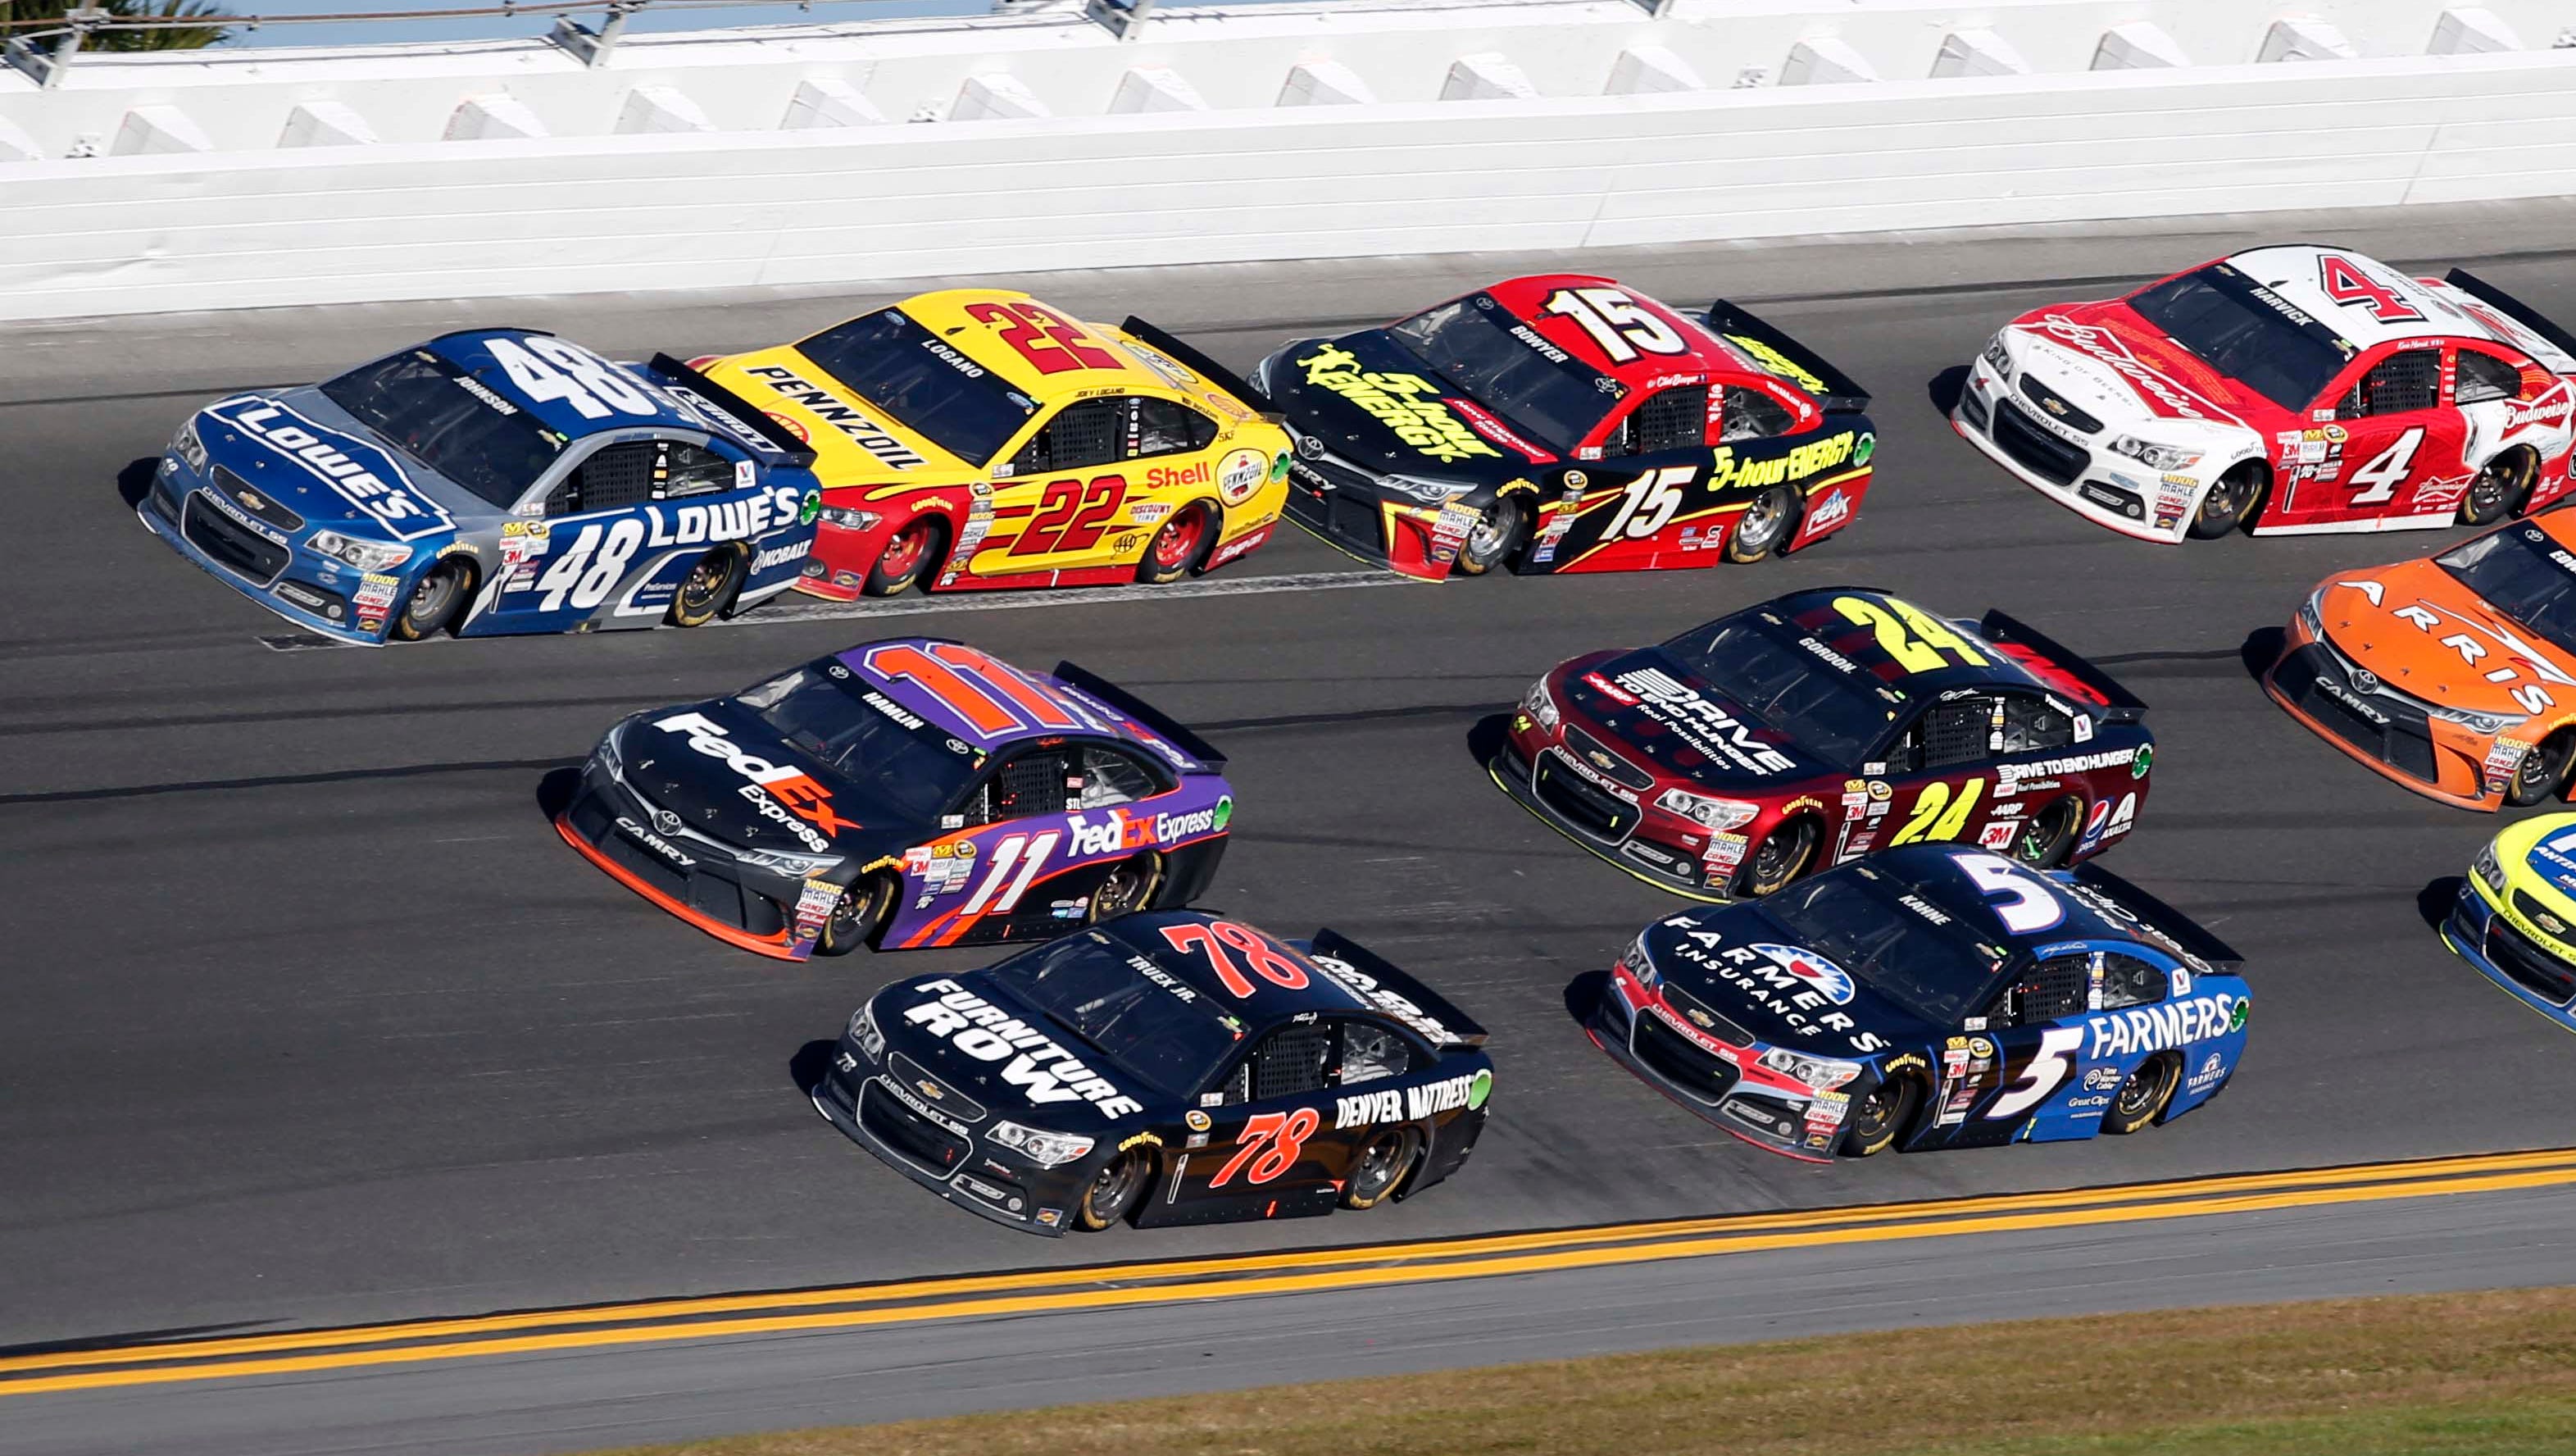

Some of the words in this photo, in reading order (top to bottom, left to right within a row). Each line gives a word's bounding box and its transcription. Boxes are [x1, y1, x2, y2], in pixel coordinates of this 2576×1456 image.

[2249, 285, 2315, 327] HARVICK
[2318, 254, 2429, 324] 4
[965, 303, 1125, 375] 22
[1510, 325, 1570, 363] BOWYER
[1545, 288, 1687, 362] 15
[484, 337, 658, 420] 48
[921, 338, 984, 379] LOGANO
[2044, 314, 2205, 419] Budweise
[452, 375, 518, 416] JOHNSON
[1096, 388, 1125, 396] LOGANO
[744, 365, 929, 472] PENNZOIL
[1218, 430, 1236, 443] SKF
[1316, 370, 1473, 460] ENERGY
[1362, 372, 1503, 458] 5-hour
[2010, 394, 2069, 435] CHEVROLET
[2073, 435, 2089, 446] SS
[236, 407, 425, 520] LOWE'S
[1147, 462, 1210, 489] Shell
[1223, 462, 1263, 494] PENNZOIL
[1707, 446, 1788, 492] 5-hour
[2163, 474, 2197, 487] MOOG
[2351, 428, 2425, 503] 4
[202, 486, 267, 533] CHEVROLET
[1129, 503, 1172, 516] DISCOUNT
[1444, 501, 1482, 517] MOOG
[1598, 466, 1698, 539] 15
[2160, 484, 2195, 497] MAHLE
[644, 486, 801, 548] LOWE'S
[1008, 475, 1128, 556] 22
[1440, 512, 1475, 526] MAHLE
[1807, 496, 1852, 531] PEAK
[436, 540, 479, 560] GOODYEAR
[504, 549, 523, 564] 3M
[534, 519, 645, 612] 48
[762, 539, 813, 567] KOBALT
[360, 582, 398, 598] MAHLE
[361, 572, 400, 585] MOOG
[1798, 637, 1857, 674] GORDON
[1831, 596, 1991, 674] 24
[2336, 580, 2556, 715] ARRIS
[862, 691, 925, 731] HAMLIN
[863, 642, 1084, 739] 11
[1588, 675, 1634, 703] AARP
[2315, 676, 2391, 725] CAMRY
[1615, 675, 1643, 694] TO
[1640, 693, 1688, 718] END
[1683, 717, 1769, 776] HUNGER
[1636, 703, 1667, 721] Real
[1663, 721, 1733, 771] Possibilities
[1554, 744, 1619, 793] CHEVROLET
[1619, 788, 1639, 803] SS
[2060, 758, 2088, 774] END
[2088, 748, 2136, 769] HUNGER
[2491, 745, 2524, 759] MAHL
[652, 712, 864, 839] FedEx
[738, 784, 829, 853] Express
[1782, 795, 1824, 816] GOODYEAR
[1847, 805, 1865, 820] 3M
[1888, 777, 1986, 847] 24
[1990, 802, 2025, 817] AARP
[615, 815, 697, 867] CAMRY
[1067, 808, 1158, 858] FedEx
[1156, 808, 1214, 844] Express
[1710, 839, 1747, 854] MAHLE
[1713, 830, 1750, 844] MOOG
[1982, 826, 2013, 846] 3M
[2100, 821, 2133, 841] AXALTA
[804, 879, 845, 895] MOOG
[913, 861, 929, 874] 3M
[960, 832, 1061, 917] 11
[1898, 894, 1951, 926] KAHNE
[1947, 853, 2067, 935] 5
[2502, 908, 2565, 955] CHEVROLET
[1125, 955, 1174, 988] TRUEX
[1170, 982, 1194, 1004] JR.
[1158, 921, 1310, 999] 78
[1664, 915, 1885, 1053] FARMERS
[1674, 942, 1823, 1039] INSURANCE
[1652, 1003, 1719, 1050] CHEVROLET
[1719, 1048, 1739, 1062] SS
[2088, 993, 2233, 1060] FARMERS
[836, 1052, 857, 1072] 78
[902, 999, 1084, 1105] ROW
[914, 978, 1144, 1121] FURNITURE
[1885, 1053, 1927, 1073] GOODYEAR
[1949, 1062, 1968, 1077] 3M
[1983, 1026, 2085, 1120] 5
[2096, 1082, 2117, 1090] Cable
[2099, 1075, 2123, 1084] Warner
[2187, 1066, 2227, 1089] FARMERS
[879, 1073, 947, 1124] CHEVROLET
[947, 1120, 970, 1136] SS
[1335, 1090, 1403, 1130] DENVER
[1406, 1074, 1472, 1121] MATTRESS
[1812, 1099, 1847, 1114] MAHLE
[1816, 1090, 1851, 1103] MOOG
[2068, 1097, 2091, 1108] Great
[2090, 1095, 2110, 1108] Clips
[1117, 1131, 1163, 1152] GOODYEAR
[1209, 1107, 1320, 1188] 78
